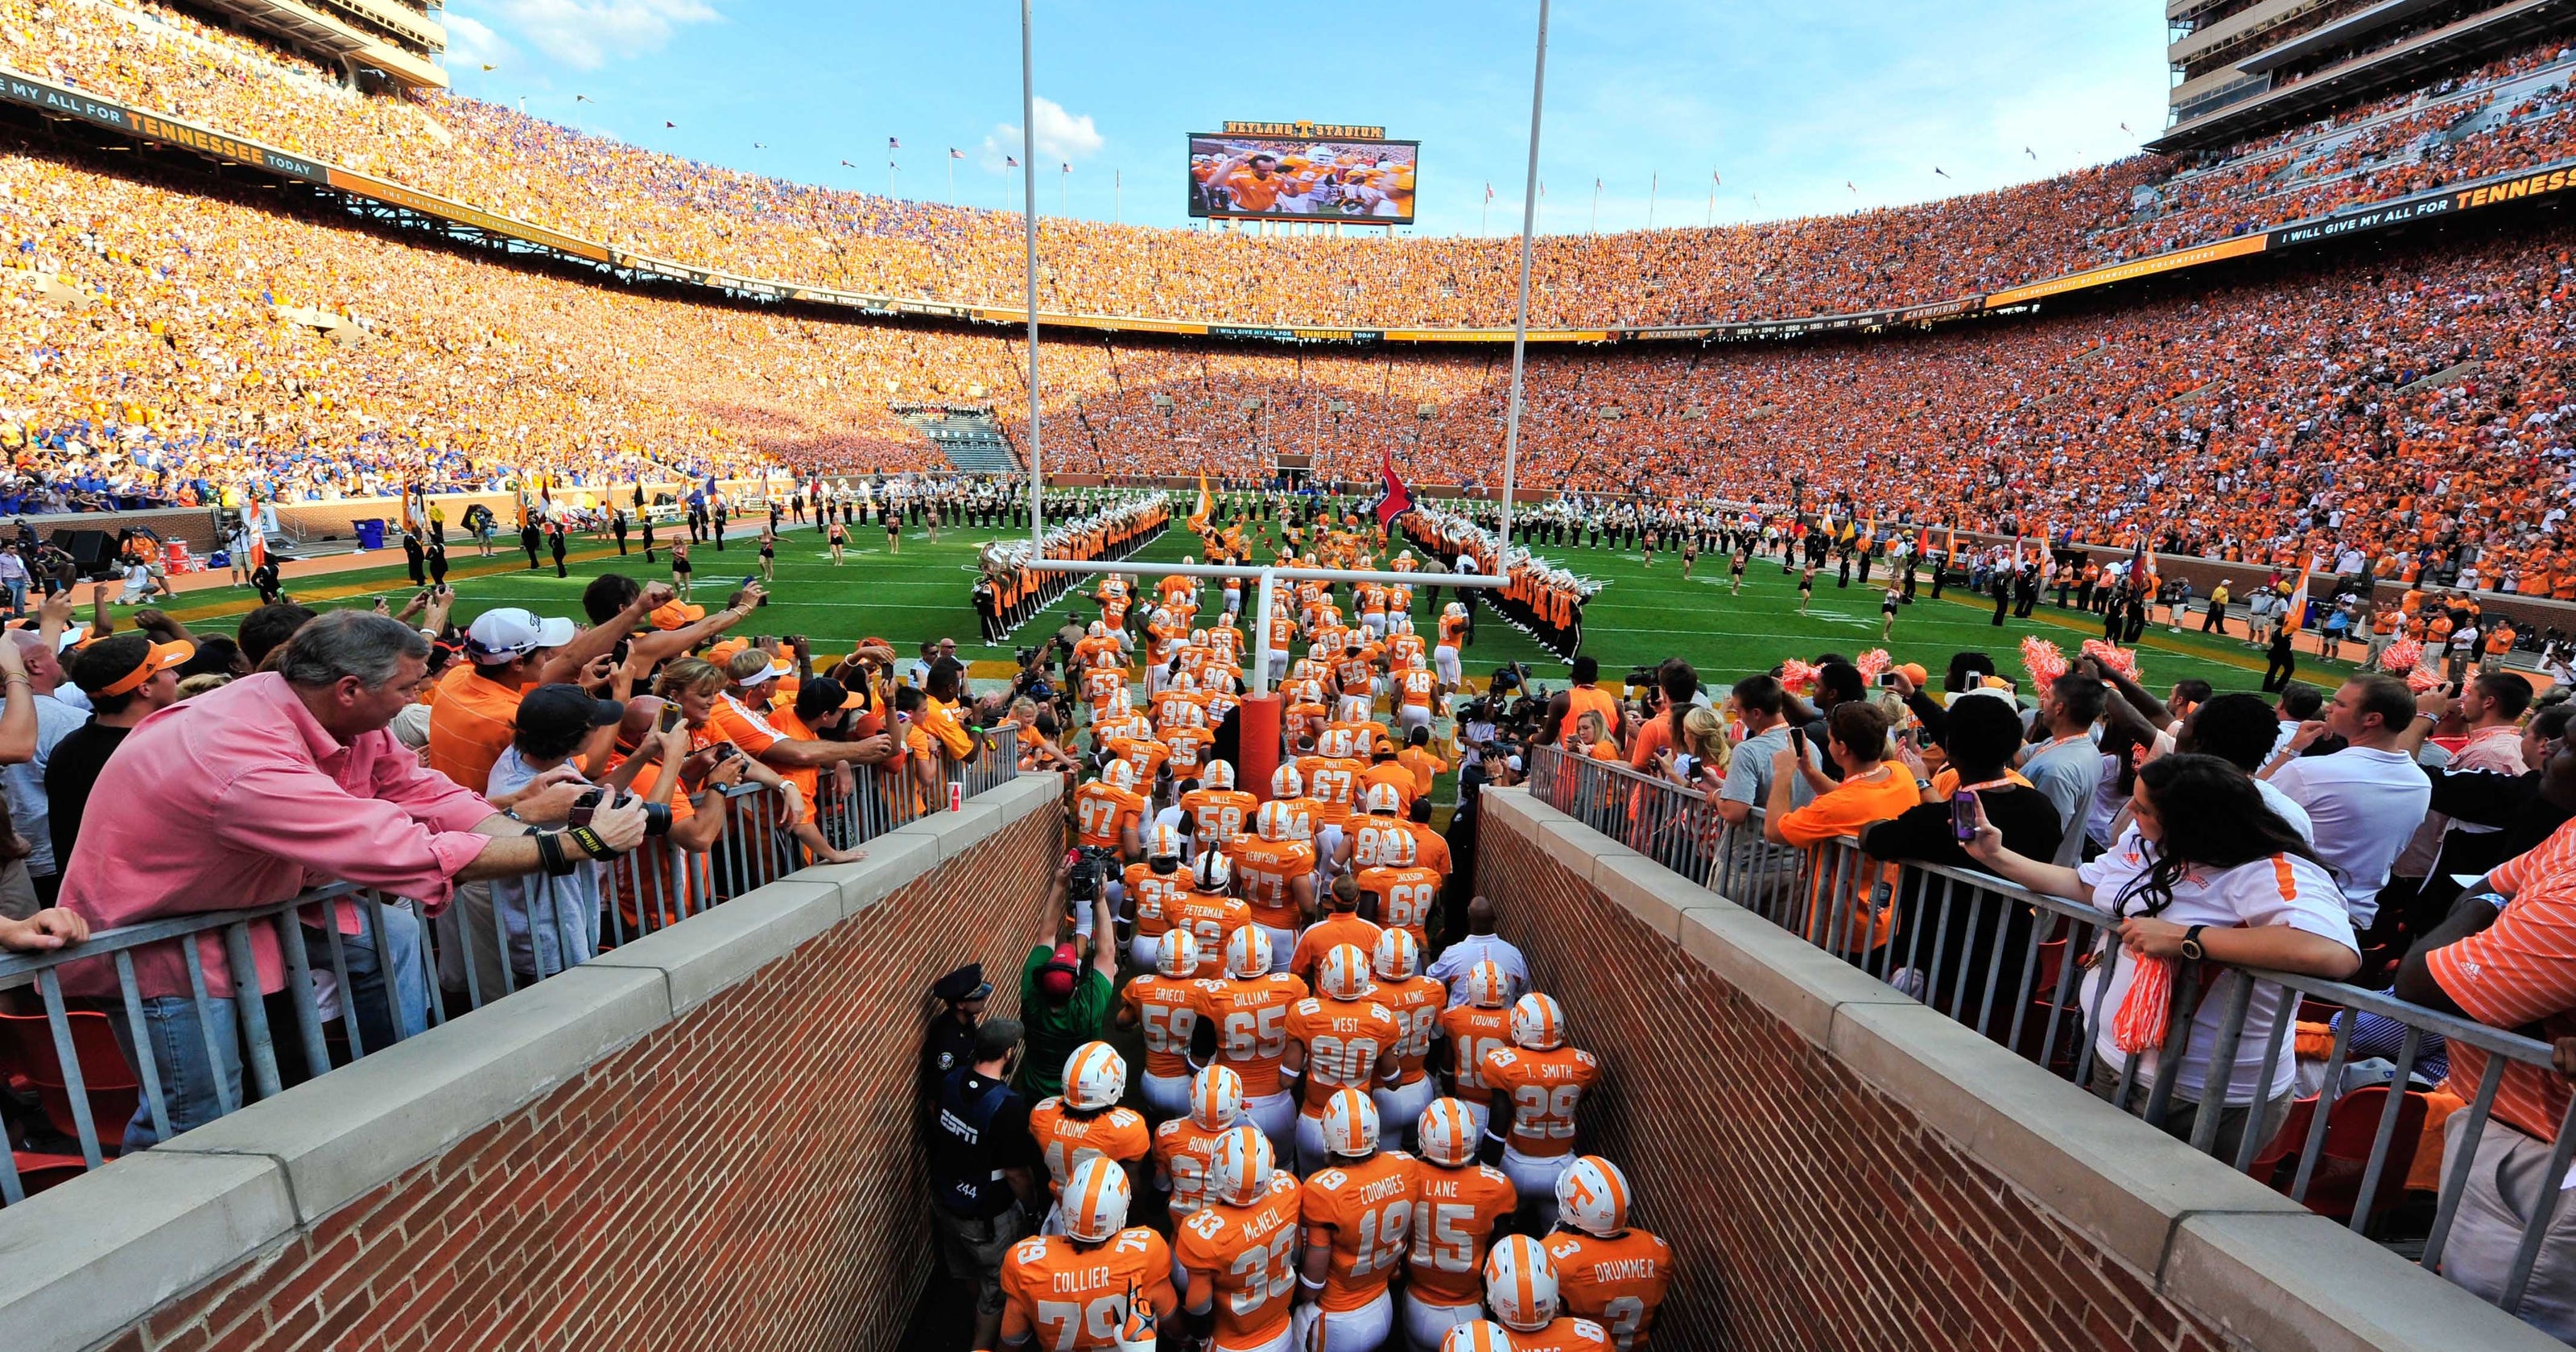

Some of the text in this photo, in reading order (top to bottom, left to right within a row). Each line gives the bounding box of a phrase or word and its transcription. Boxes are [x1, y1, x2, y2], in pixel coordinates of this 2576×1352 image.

[12, 83, 39, 100] MY
[47, 93, 80, 112] ALL
[87, 104, 121, 122] FOR
[126, 113, 264, 164] TENNESSEE
[267, 155, 311, 175] TODAY
[1227, 122, 1293, 135] NEYLAND
[1315, 126, 1383, 138] STADIUM
[382, 189, 401, 200] THE
[407, 196, 467, 220] UNIVERSITY
[2282, 233, 2287, 243] I
[2291, 228, 2321, 241] WILL
[2324, 219, 2355, 235] GIVE
[2359, 213, 2380, 228] MY
[2384, 208, 2411, 222] ALL
[2416, 200, 2449, 216] FOR
[2095, 266, 2145, 282] TENNESSEE
[2150, 250, 2216, 270] VOLUNTEERS
[1906, 303, 1961, 319] CHAMPIONS
[1294, 330, 1352, 339] TENNESSEE
[1648, 330, 1699, 338] NATIONAL
[1368, 589, 1385, 606] 72
[1179, 651, 1203, 671] 54
[1395, 641, 1418, 660] 57
[1092, 673, 1119, 697] 53
[1338, 660, 1367, 686] 56
[1406, 672, 1430, 693] 48
[1167, 737, 1199, 766] 35
[1130, 752, 1151, 785] 7
[1312, 769, 1352, 804] 67
[1209, 795, 1231, 805] WALLS
[1288, 802, 1305, 811] RLEY
[1079, 797, 1117, 839] 97
[1197, 806, 1242, 843] 58
[1369, 818, 1393, 829] DOWNS
[578, 828, 602, 853] Nikon
[1245, 850, 1279, 866] KERBYSON
[1240, 867, 1284, 909] 77
[1396, 871, 1424, 883] JACKSON
[1183, 903, 1225, 920] PETERMAN
[1388, 883, 1434, 927] 68
[1154, 987, 1186, 1003] GRIECO
[1233, 990, 1271, 1007] GILLIAM
[1393, 991, 1426, 1007] J. KING
[1141, 1004, 1198, 1056] 59
[1225, 1005, 1286, 1061] 65
[1331, 1016, 1360, 1033] WEST
[1470, 1013, 1501, 1028] YOUNG
[1311, 1035, 1378, 1089] 80
[1488, 1048, 1517, 1069] 29
[1542, 1063, 1573, 1080] SMITH
[1513, 1083, 1583, 1140] 29
[940, 1107, 978, 1145] ESPN
[1054, 1118, 1090, 1140] CRUMP
[1187, 1136, 1214, 1154] BONN
[956, 1179, 977, 1199] 244
[1360, 1174, 1406, 1206] COOMBES
[1425, 1180, 1458, 1198] LANE
[1187, 1208, 1226, 1240] 33
[1241, 1206, 1284, 1243] McNEIL
[1017, 1238, 1046, 1265] 79
[1114, 1229, 1151, 1255] 79
[1349, 1199, 1413, 1278] 19
[1410, 1203, 1475, 1274] 15
[1551, 1239, 1583, 1259] 3
[1053, 1265, 1110, 1294] COLLIER
[1230, 1222, 1298, 1317] 33
[1593, 1258, 1656, 1284] DRUMMER
[1037, 1292, 1129, 1352] 79
[1604, 1296, 1645, 1352] 3
